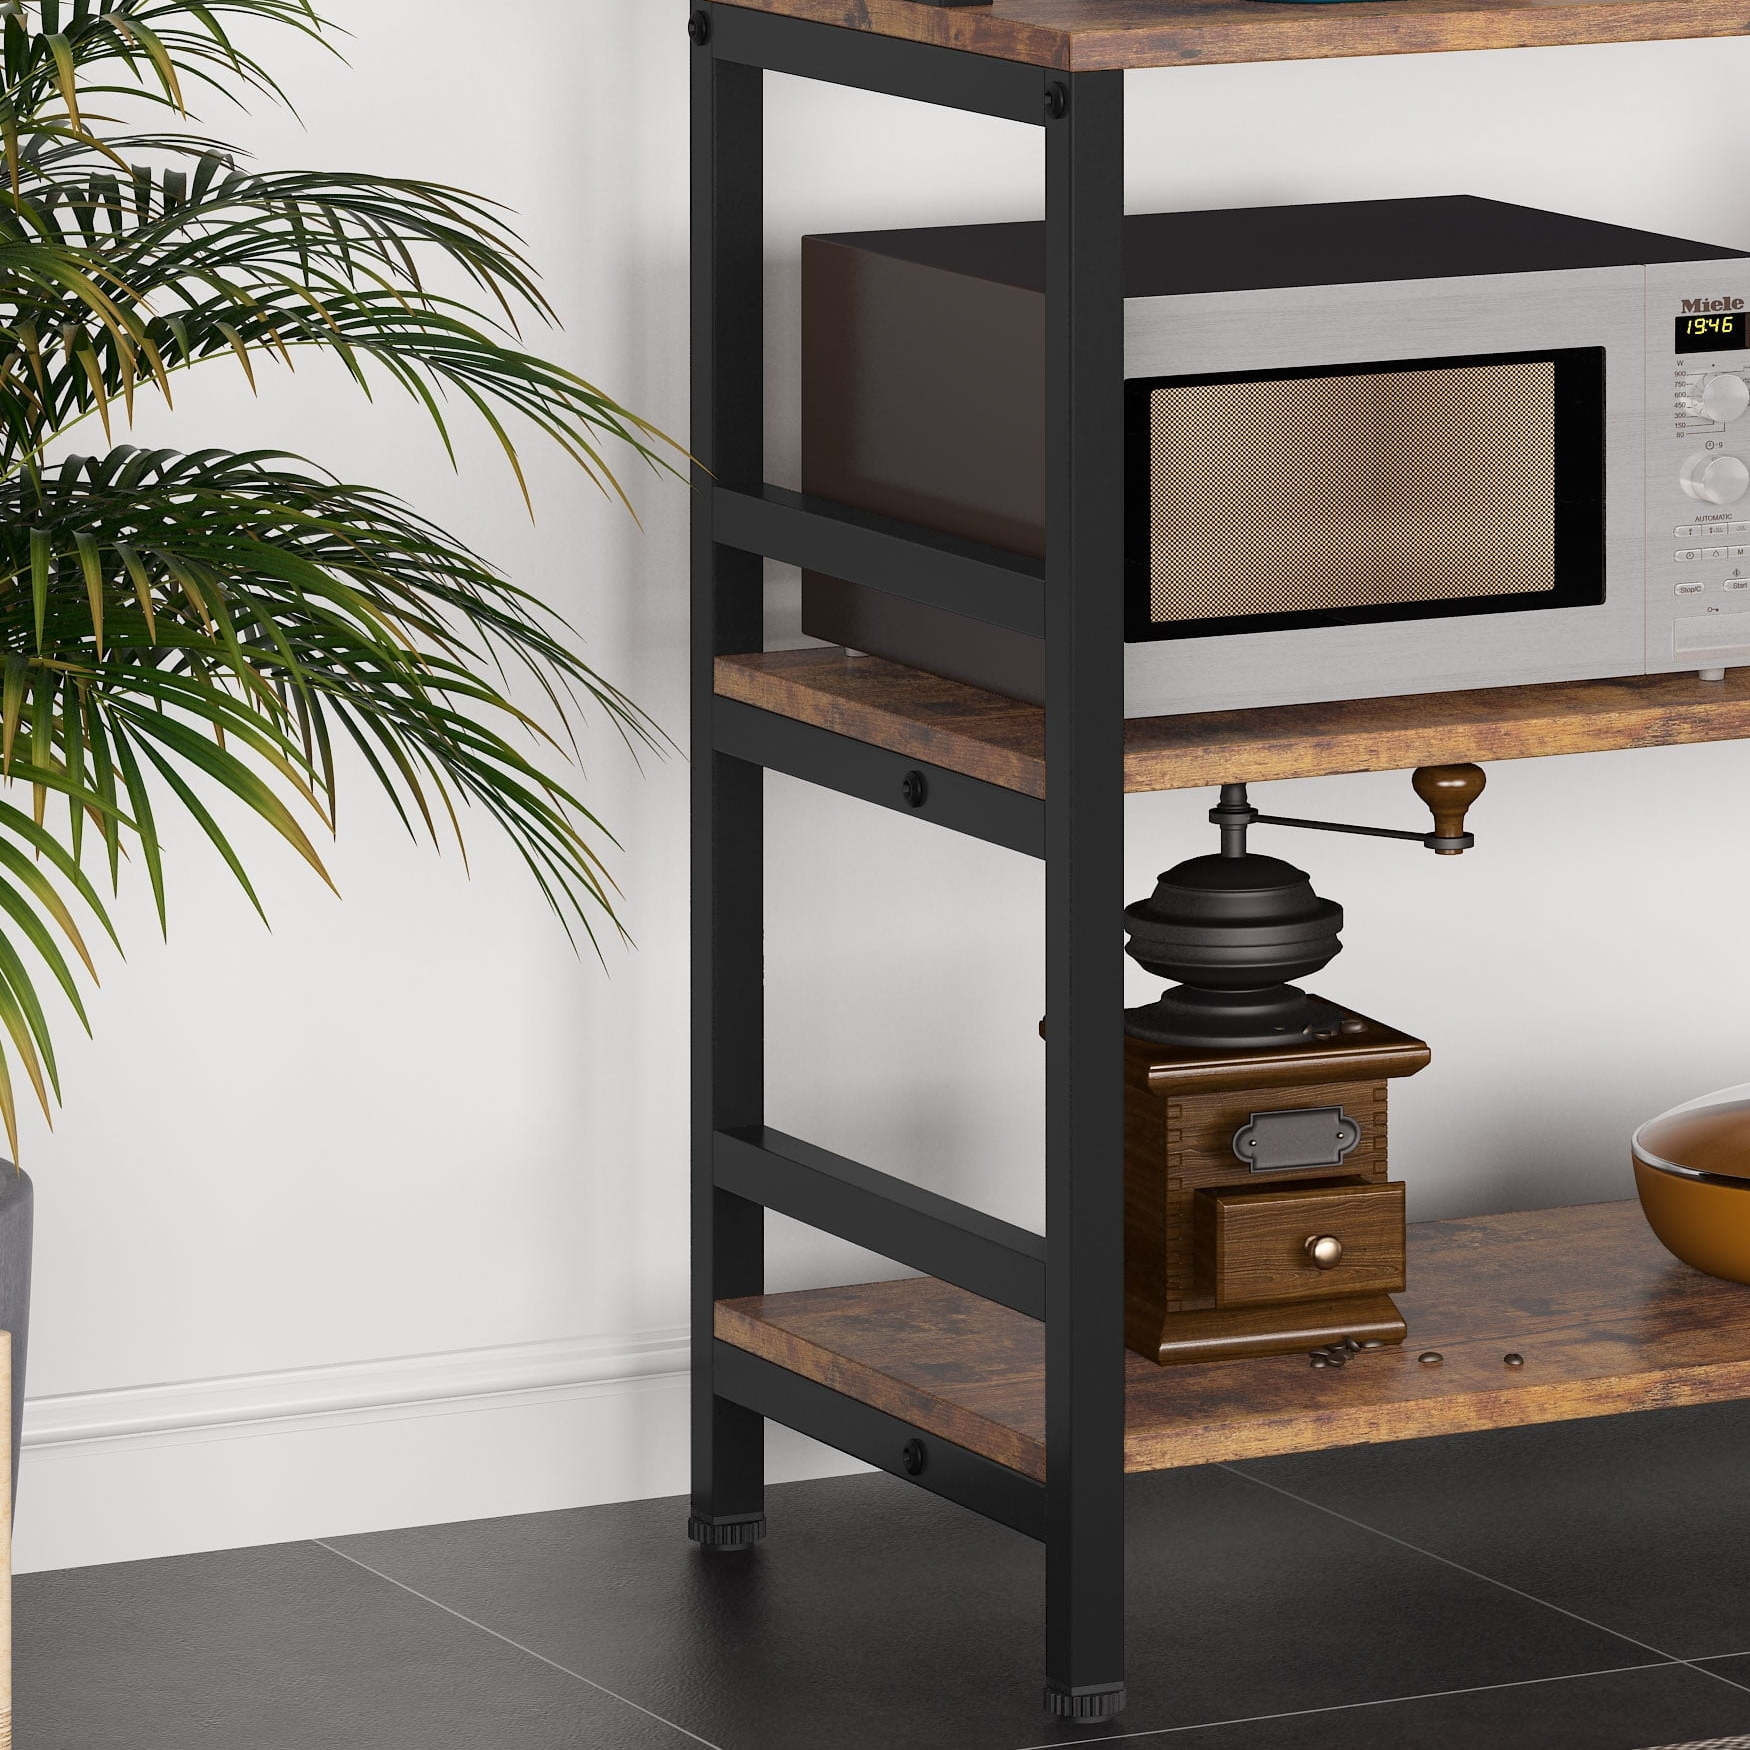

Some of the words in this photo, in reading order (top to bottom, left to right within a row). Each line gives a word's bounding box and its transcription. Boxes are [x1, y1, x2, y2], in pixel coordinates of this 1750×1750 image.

[1681, 296, 1745, 313] Miele
[1686, 316, 1734, 335] 19:46
[1694, 513, 1733, 523] AUTOMATIC
